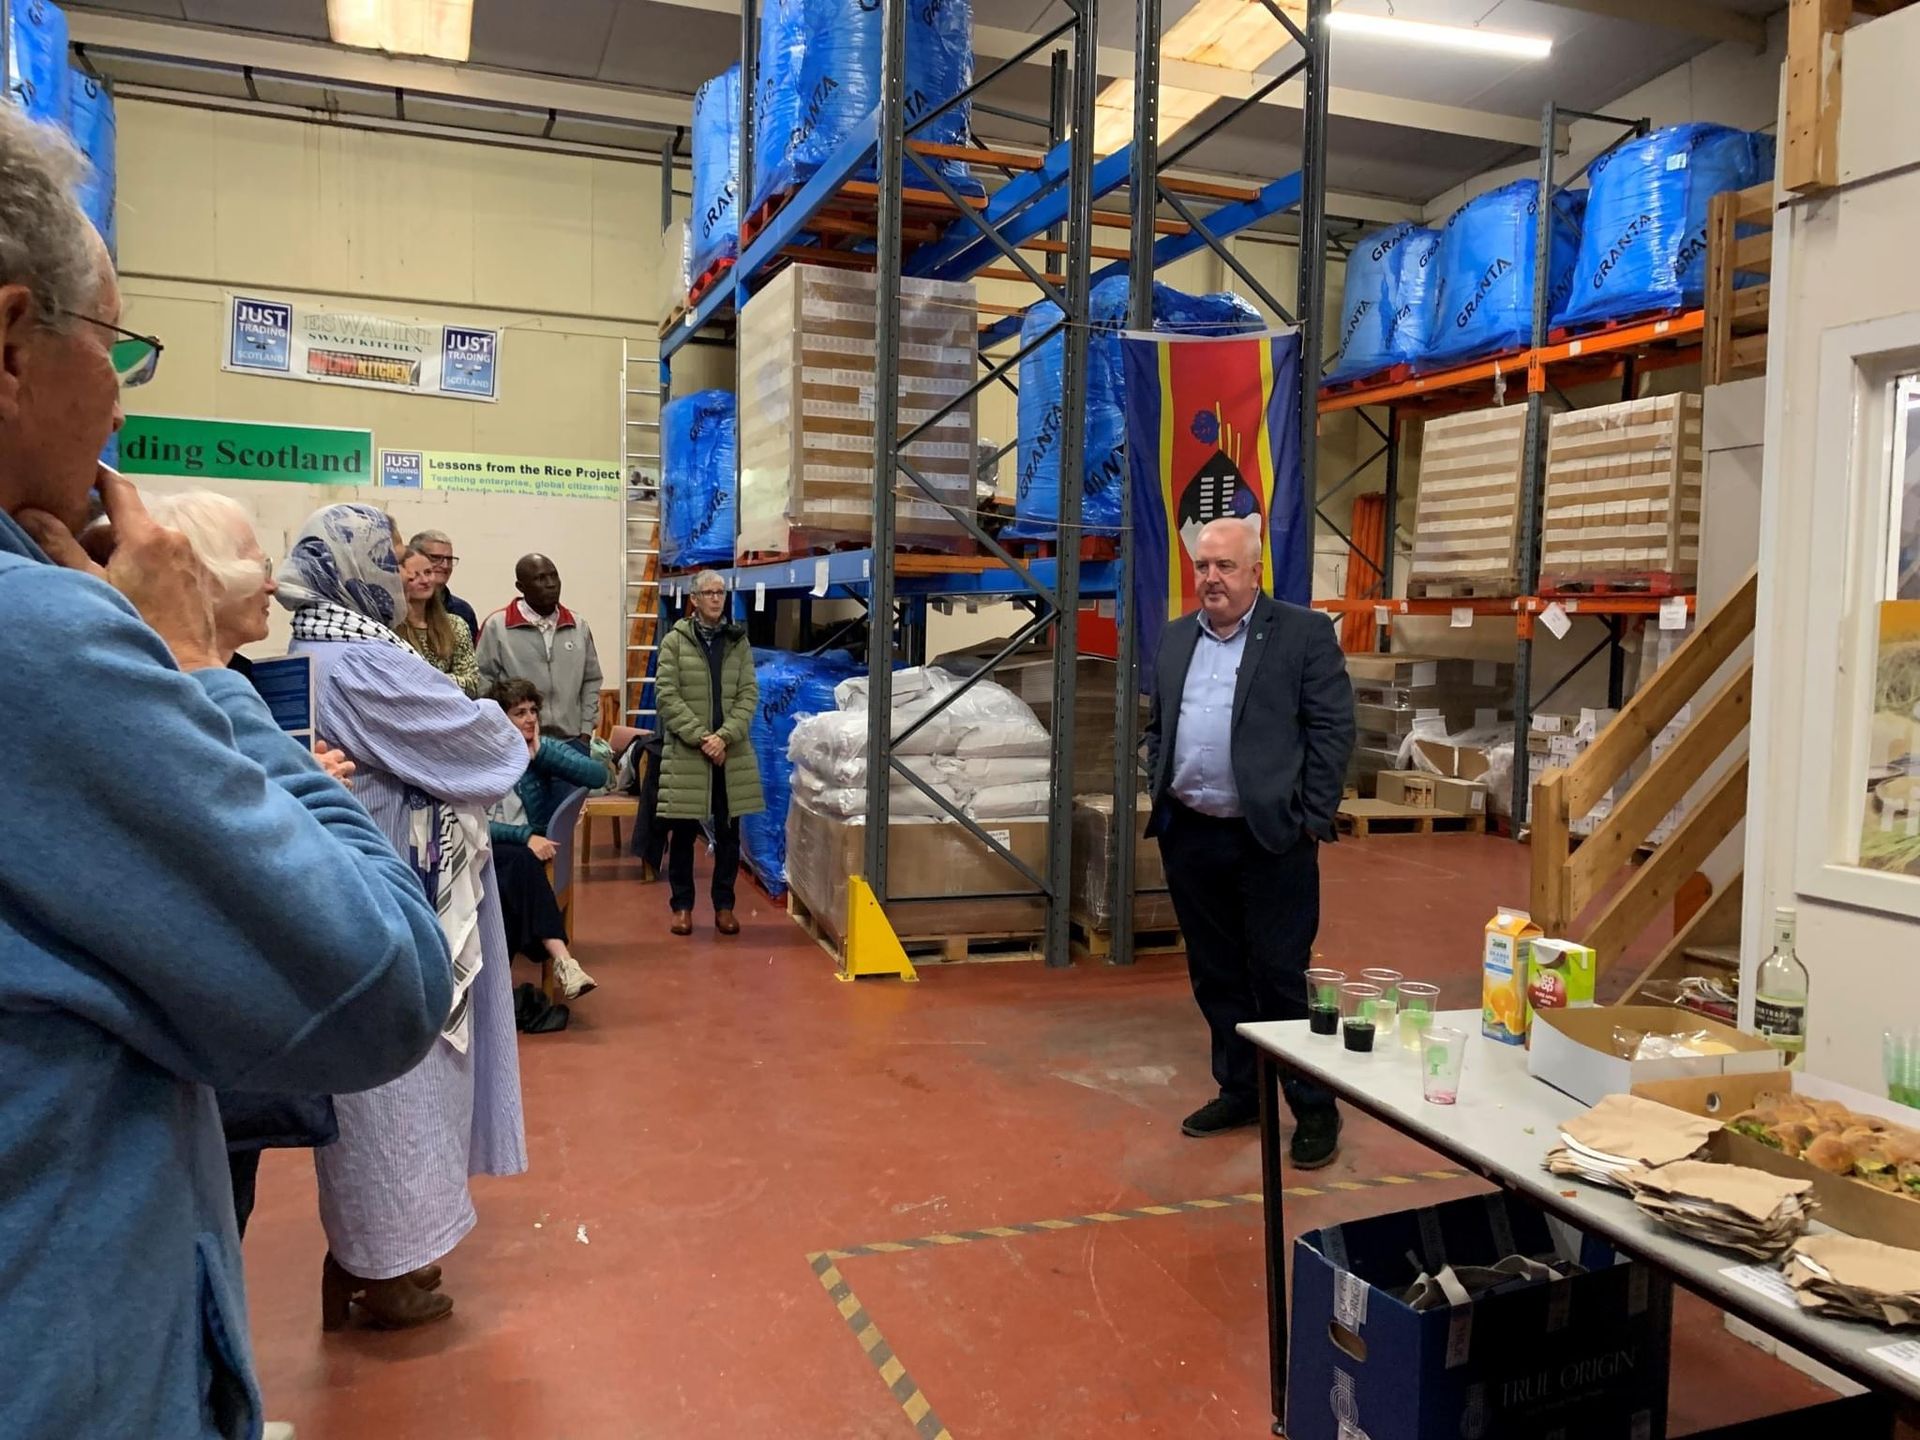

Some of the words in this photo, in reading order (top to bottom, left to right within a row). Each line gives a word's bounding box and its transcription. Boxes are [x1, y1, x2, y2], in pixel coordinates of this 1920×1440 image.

[1593, 214, 1651, 290] GRANTA
[1456, 258, 1512, 328] GRANTA
[239, 305, 286, 326] JUST
[239, 322, 287, 337] TRADING
[360, 338, 423, 353] KITCHEN
[448, 333, 491, 353] JUST
[238, 350, 284, 363] SCOTLAND
[448, 350, 491, 363] TRADING
[357, 358, 411, 384] KITCHEN
[446, 375, 489, 389] SCOTLAND
[126, 434, 204, 470] ding
[215, 438, 362, 473] Scotland
[385, 455, 418, 468] JUST
[1019, 404, 1063, 499] GRANTA
[386, 466, 419, 475] TRADING
[429, 458, 482, 472] Lessons
[487, 461, 516, 474] from
[520, 464, 540, 475] the
[544, 465, 572, 477] Rice
[576, 467, 621, 481] Project
[431, 473, 476, 486] Teaching
[535, 479, 565, 491] global
[567, 482, 619, 494] citizenship
[1560, 1343, 1639, 1391] ORIGIN
